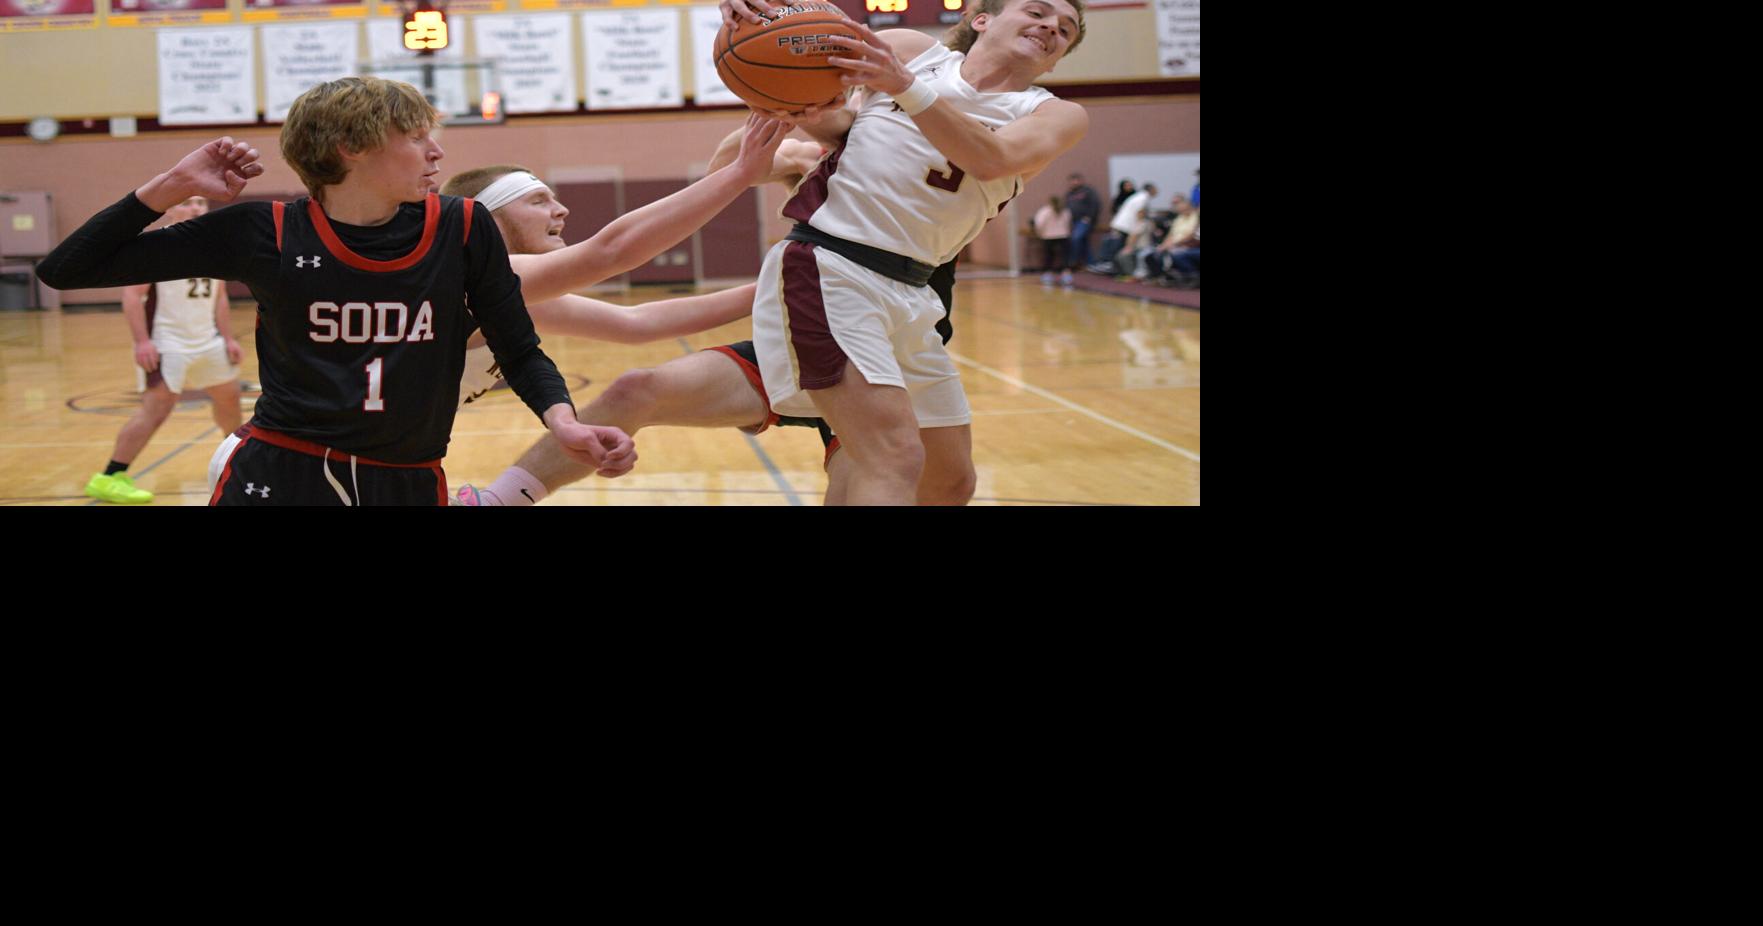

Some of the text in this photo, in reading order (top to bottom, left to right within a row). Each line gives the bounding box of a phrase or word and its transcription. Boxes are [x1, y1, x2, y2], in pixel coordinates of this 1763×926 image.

[187, 277, 212, 299] 23
[308, 300, 435, 344] SODA
[363, 356, 385, 411] 1
